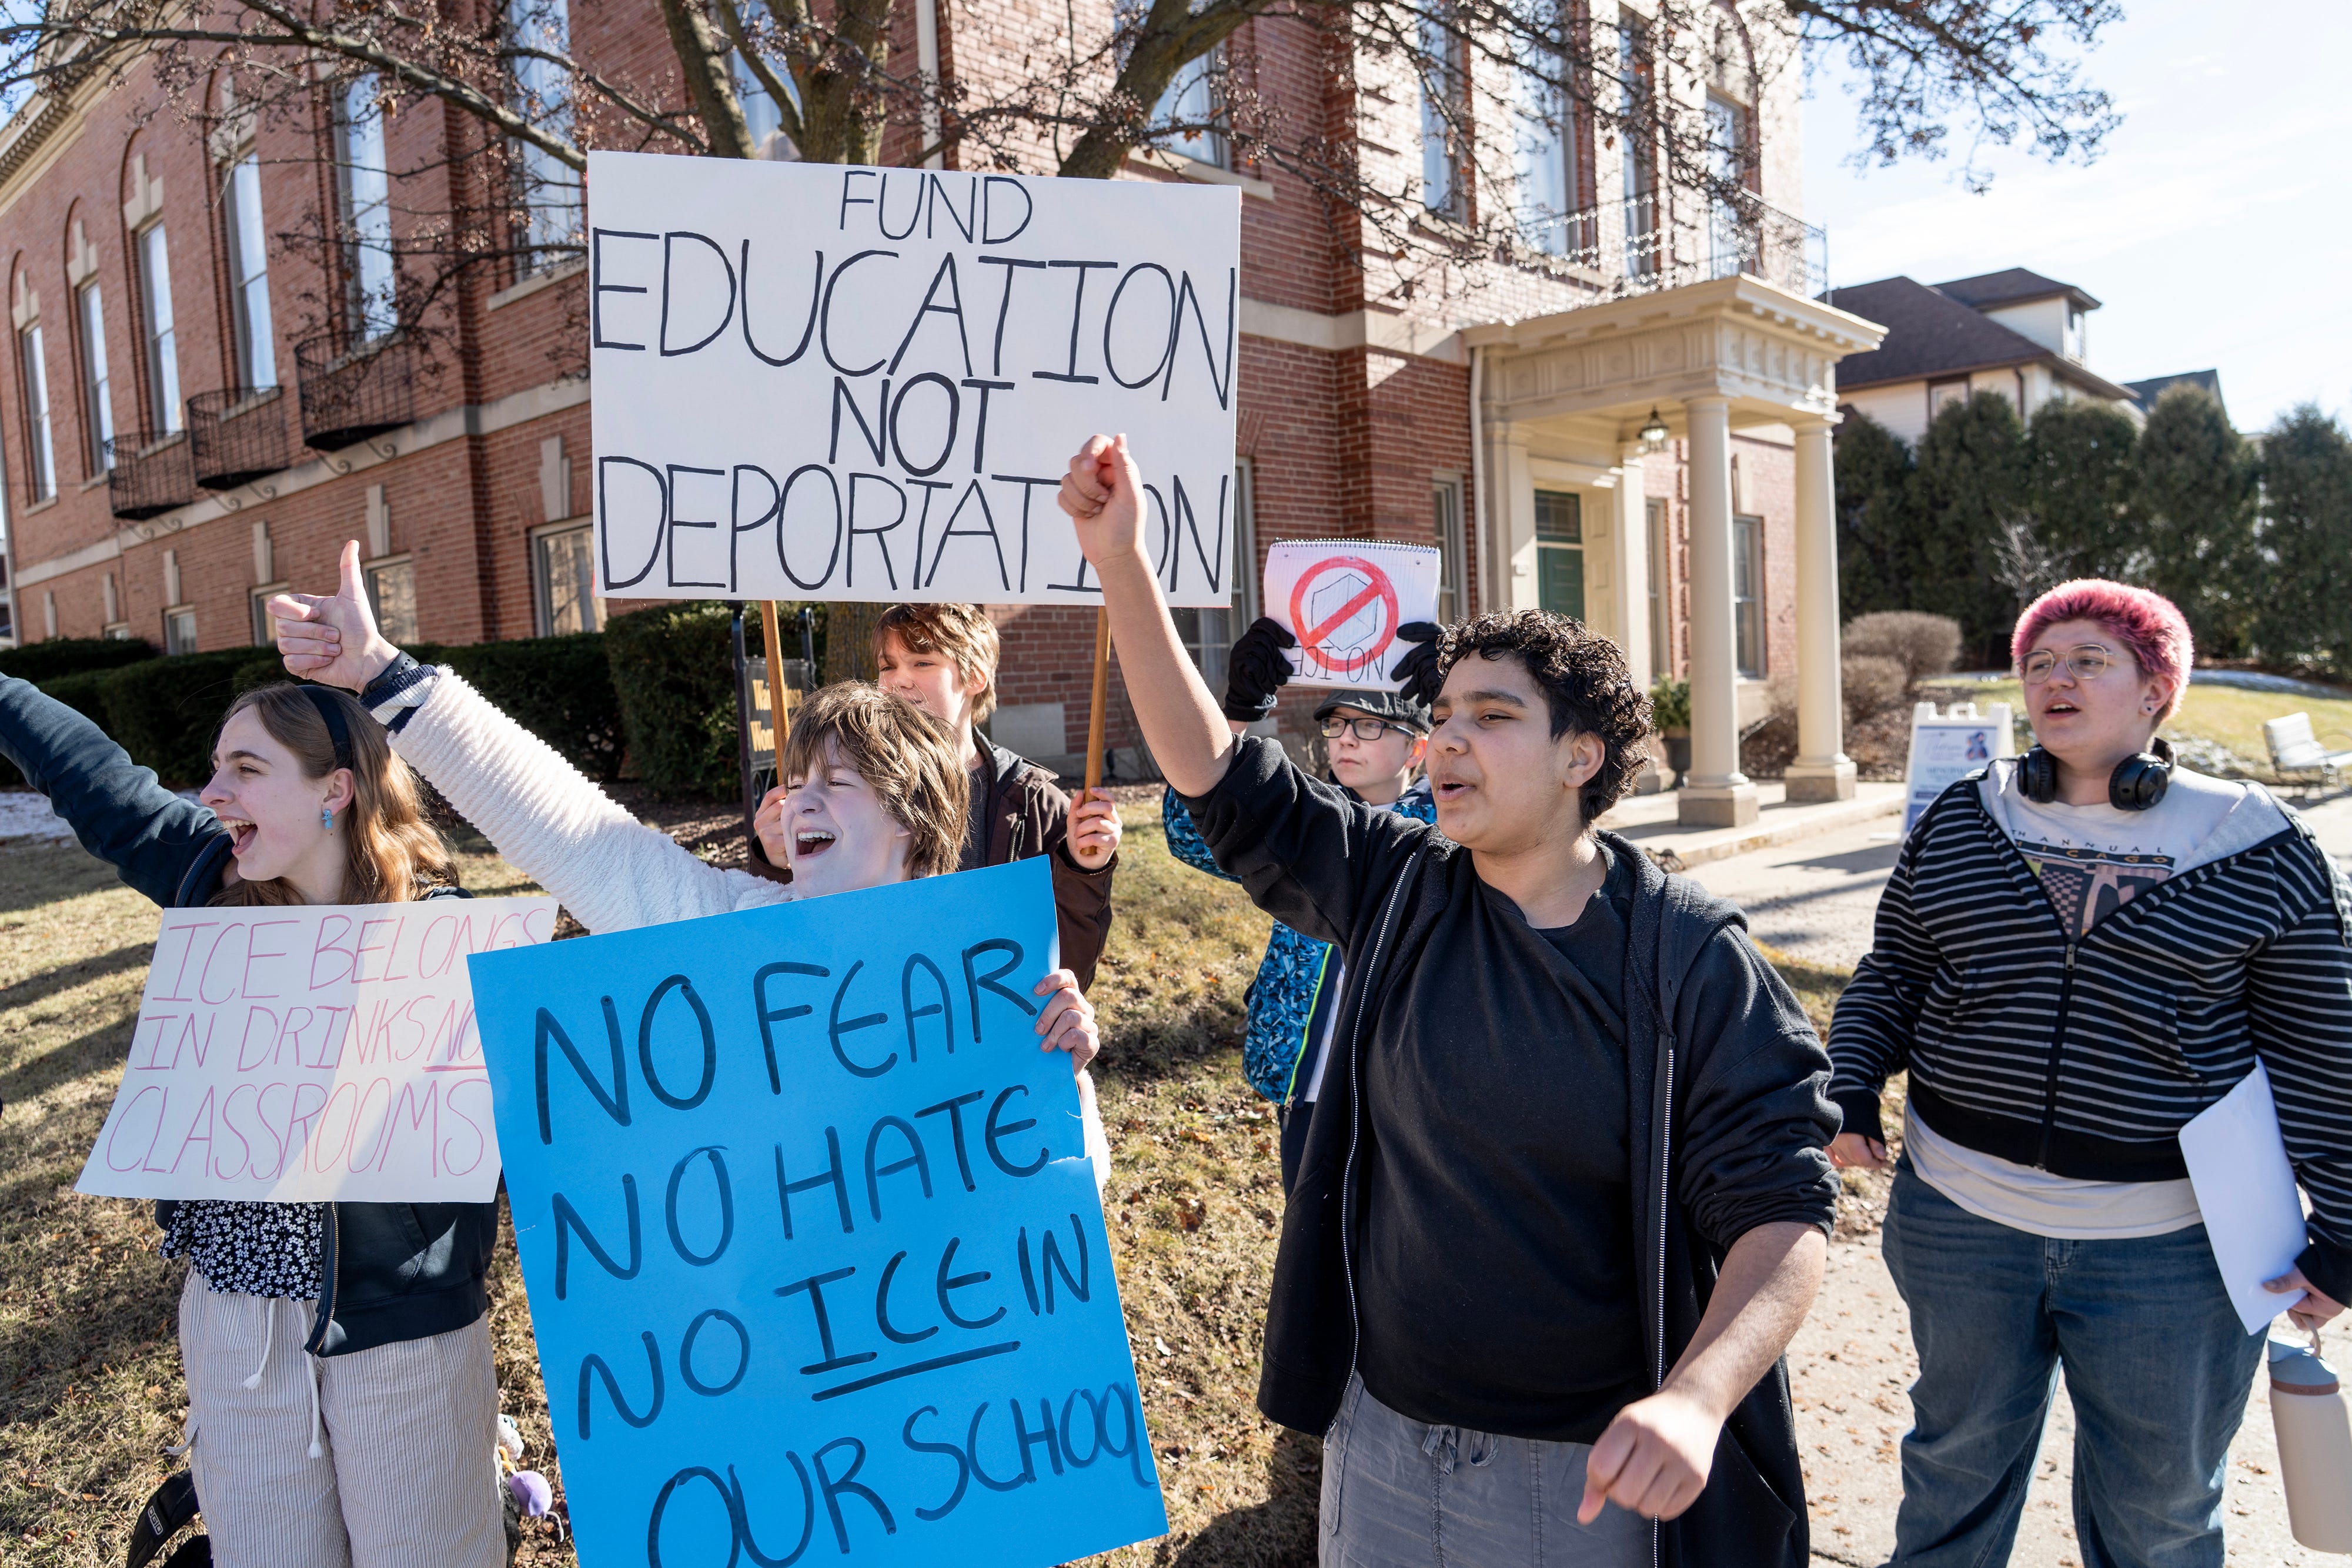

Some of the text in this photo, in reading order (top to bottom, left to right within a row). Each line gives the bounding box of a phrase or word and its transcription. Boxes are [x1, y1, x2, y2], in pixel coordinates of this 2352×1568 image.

[840, 171, 1033, 244] FUND
[593, 227, 1236, 410] EDUCATION
[829, 372, 1015, 475] NOT
[2016, 841, 2168, 863] HICAGO
[2040, 837, 2166, 853] ANNUAL
[152, 920, 301, 1005] ICE
[134, 1012, 216, 1071] IN
[236, 995, 436, 1072] DRINKS
[534, 938, 1037, 1146] NO FEAR
[106, 1077, 490, 1180] CLASSROOMS
[552, 1084, 1050, 1300] NO HATE
[577, 1213, 1091, 1441] NO ICE IN
[148, 1505, 163, 1535] OGIO
[647, 1435, 897, 1568] OUR
